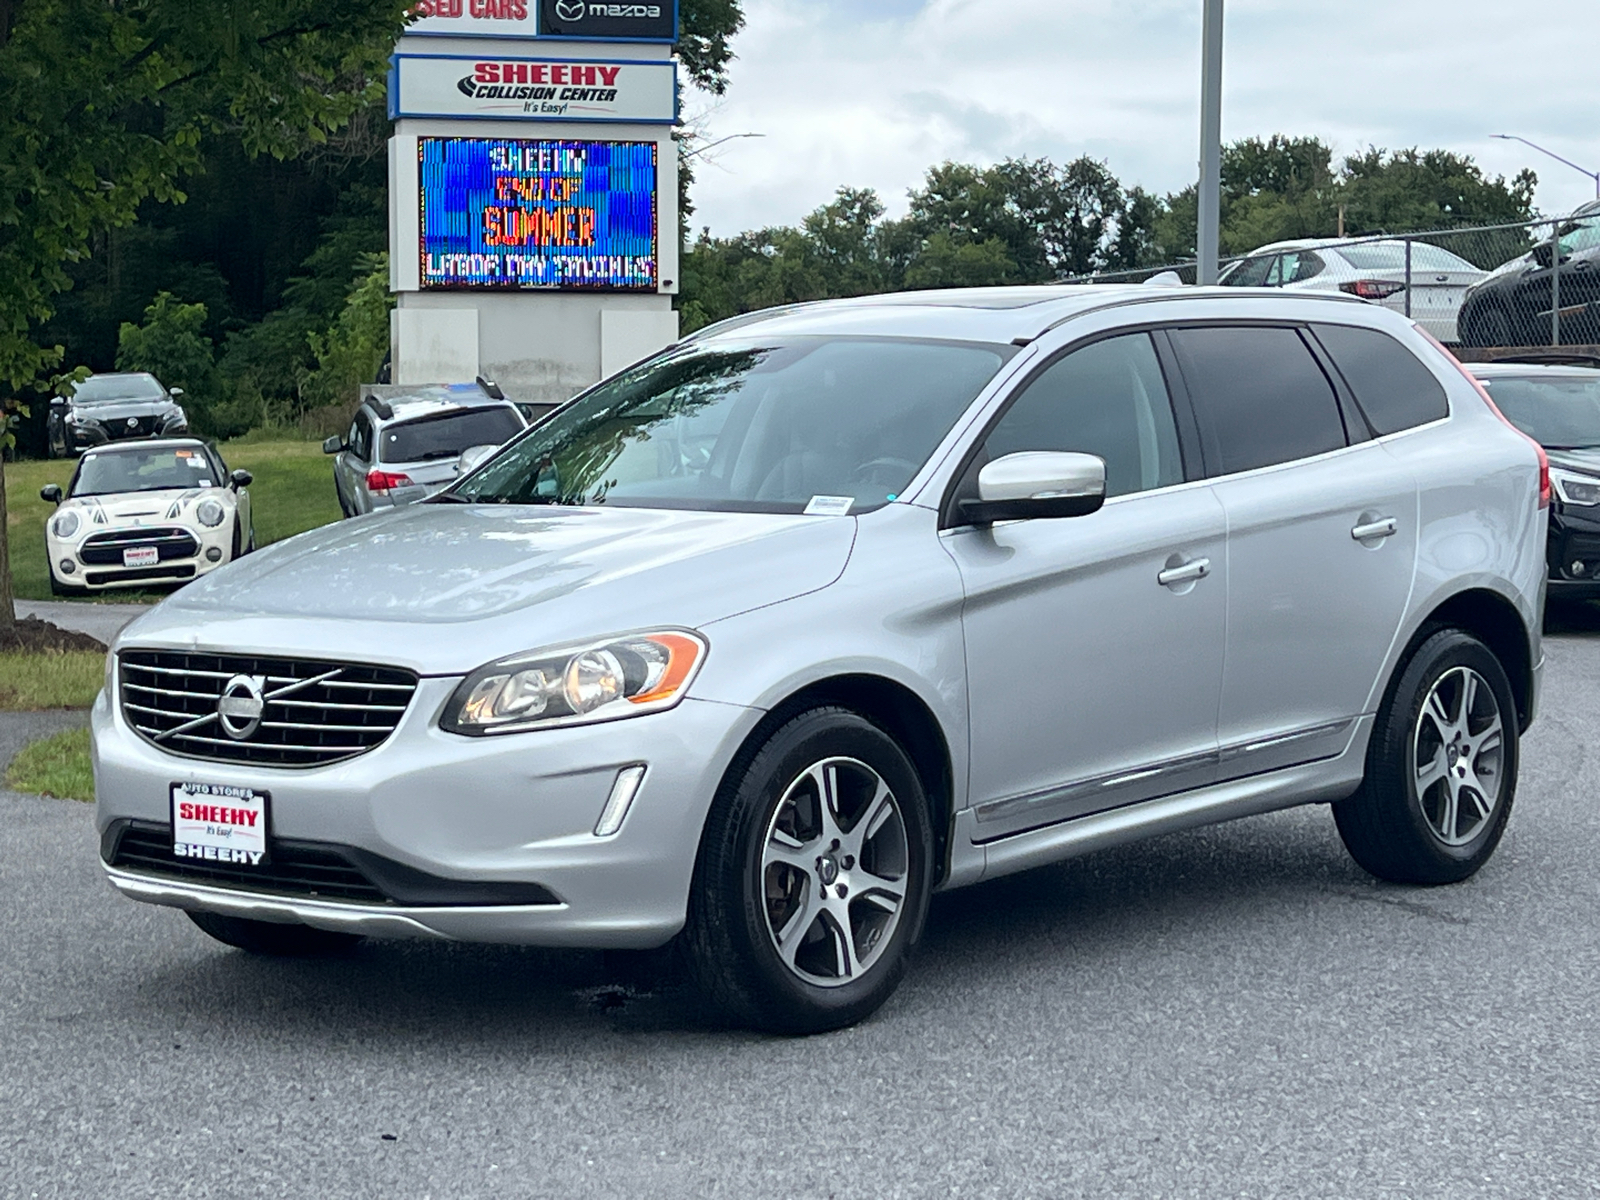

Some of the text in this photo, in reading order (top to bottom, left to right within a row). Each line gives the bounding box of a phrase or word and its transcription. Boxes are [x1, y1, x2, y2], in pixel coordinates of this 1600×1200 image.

[469, 0, 528, 20] CARS
[589, 4, 660, 18] mazda
[474, 63, 621, 86] SHEEHY
[475, 85, 618, 102] COLLISION CENTER
[523, 102, 568, 115] It's Easy!
[484, 206, 595, 246] SUMMER
[180, 783, 253, 797] AUTO STORES
[180, 803, 258, 827] SHEEHY
[174, 842, 263, 865] SHEEHY
